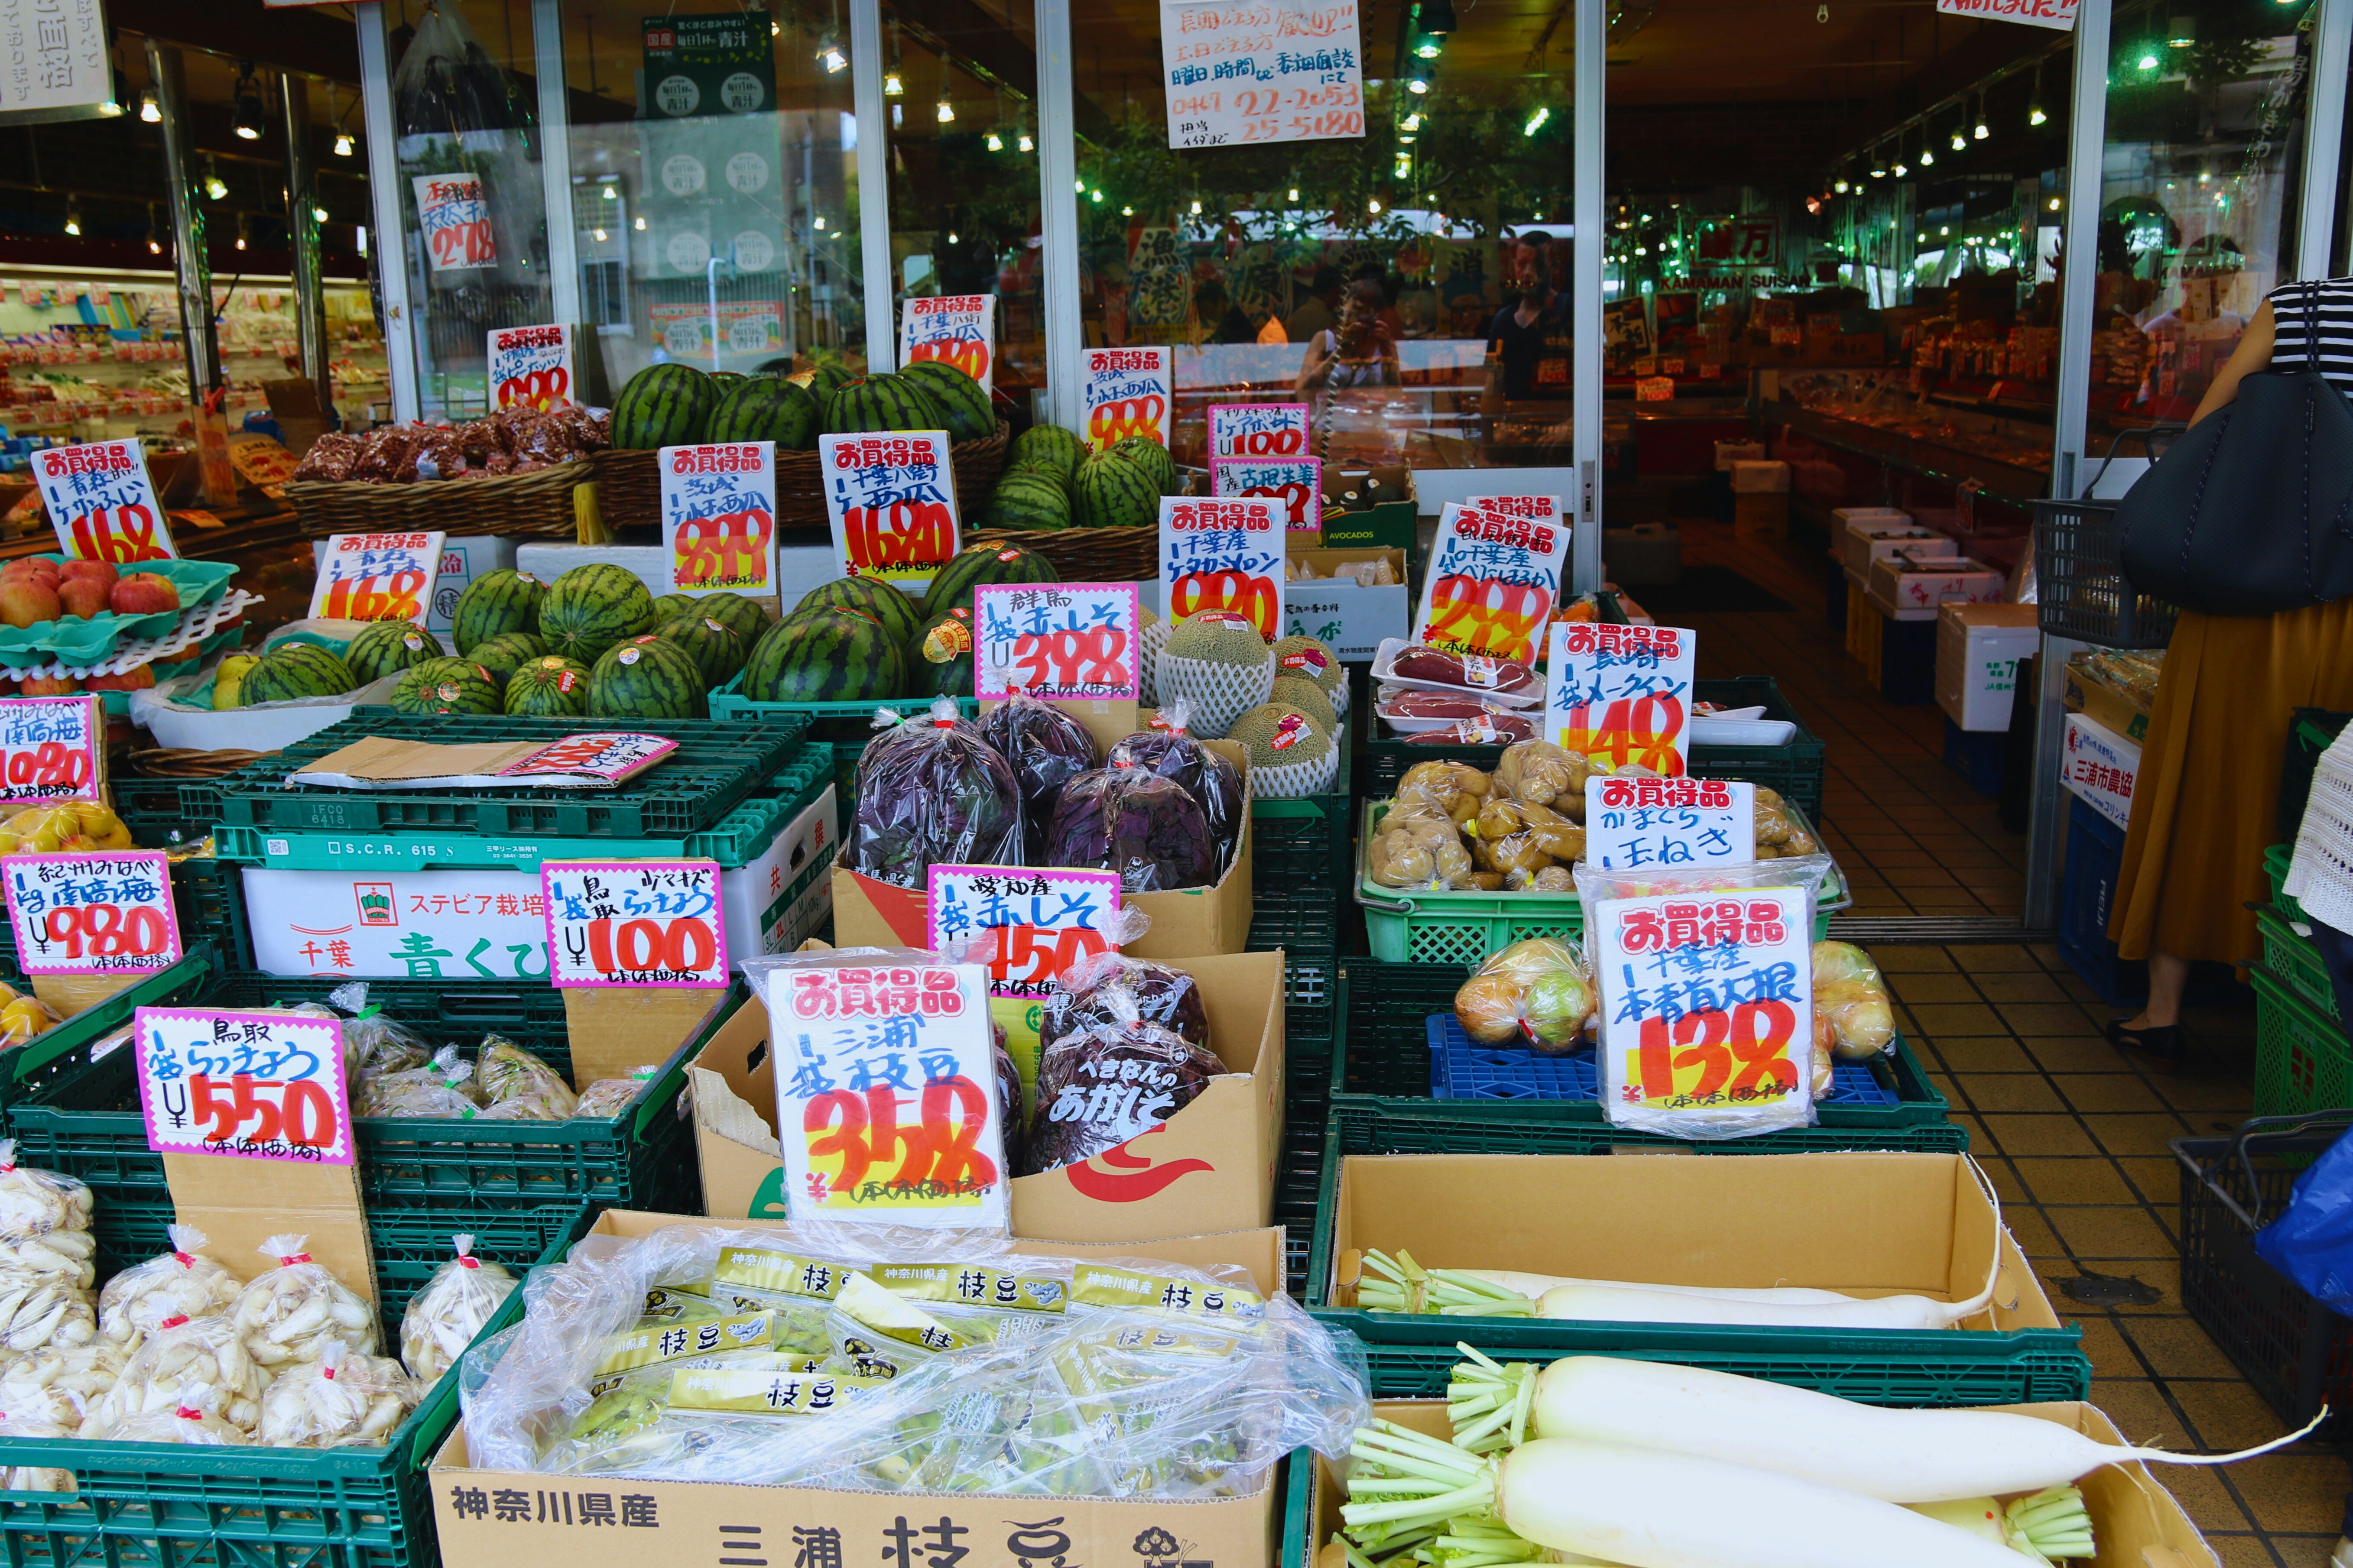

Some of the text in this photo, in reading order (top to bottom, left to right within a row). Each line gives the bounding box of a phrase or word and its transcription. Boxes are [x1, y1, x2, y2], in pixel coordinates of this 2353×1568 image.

[647, 32, 673, 47] 国産
[677, 30, 750, 48] 毎日1杯の青汁
[1320, 71, 1347, 85] にて
[666, 97, 689, 110] 青汁
[731, 95, 755, 108] 青汁
[1172, 84, 1360, 117] 0467 22-2053
[1179, 120, 1208, 134] 担当
[1240, 109, 1363, 143] 25-5180
[432, 218, 497, 266] 278
[1660, 274, 1811, 290] KAMAMAN SUISAN
[912, 296, 983, 315] お買得品
[506, 355, 563, 379] ピーナッツ
[1088, 350, 1162, 373] お買得品
[835, 439, 938, 470] お買得品
[1233, 428, 1303, 455] 100
[43, 445, 133, 476] お買得品
[672, 444, 763, 475] お買得品
[863, 484, 949, 510] 西瓜
[1477, 496, 1554, 518] お買得品
[1171, 502, 1272, 531] お買得品
[1455, 509, 1557, 554] お買得品
[71, 503, 173, 564] 168
[339, 533, 428, 552] お買得品
[1181, 527, 1251, 554] 千葉産
[1328, 531, 1374, 540] AVOCADOS
[327, 570, 427, 622] 168
[1009, 589, 1072, 613] 群馬
[1284, 603, 1340, 614] 天然の香辛料
[1021, 601, 1126, 637] 赤しそ
[1013, 624, 1131, 690] 398
[1566, 625, 1681, 659] お買得品
[1584, 673, 1688, 705] メークイン
[1567, 690, 1684, 778] 148
[1602, 779, 1730, 809] お買得品
[2074, 758, 2134, 799] 三浦市農協
[312, 805, 344, 814] IFCO
[312, 814, 345, 824] 6418
[1600, 805, 1701, 831] かまくら
[344, 842, 402, 855] S.C.R.
[411, 844, 437, 856] 615
[1617, 815, 1734, 868] 玉ねぎ
[52, 877, 161, 907] 南高梅
[770, 863, 781, 896] 共
[409, 893, 545, 917] ステビア栽培
[583, 875, 621, 920] 鳥取
[623, 884, 715, 919] らっきょう
[975, 891, 1100, 930] 赤しそ
[29, 902, 168, 959] ¥ 980
[765, 937, 774, 952] 3L
[776, 920, 785, 940] 2L
[788, 910, 793, 925] L
[1623, 902, 1783, 952] お買得品
[298, 939, 356, 969] 千葉
[565, 917, 717, 974] ¥ 100
[795, 968, 961, 1016] お買得品
[1651, 960, 1804, 1026] 青首大根
[211, 1017, 273, 1046] 鳥取
[832, 1013, 927, 1056] 三浦
[187, 1040, 321, 1082] らっきょう
[1622, 998, 1799, 1104] ¥ 138
[842, 1047, 968, 1093] 枝豆
[1077, 1058, 1178, 1088] へきなんの
[162, 1072, 338, 1149] ¥ 550
[1048, 1082, 1176, 1142] あかしそ
[803, 1074, 998, 1203] ¥ 358
[730, 1251, 795, 1274] 神奈川県産
[884, 1266, 1021, 1303] 神奈川県産 枝豆
[1086, 1270, 1227, 1313] 神奈川県産 枝豆
[658, 1321, 721, 1357] 枝豆
[1114, 1328, 1181, 1348] 枝豆
[766, 1377, 838, 1409] 枝豆
[450, 1485, 660, 1528] 神奈川県産
[718, 1515, 1085, 1568] 三浦 枝豆
